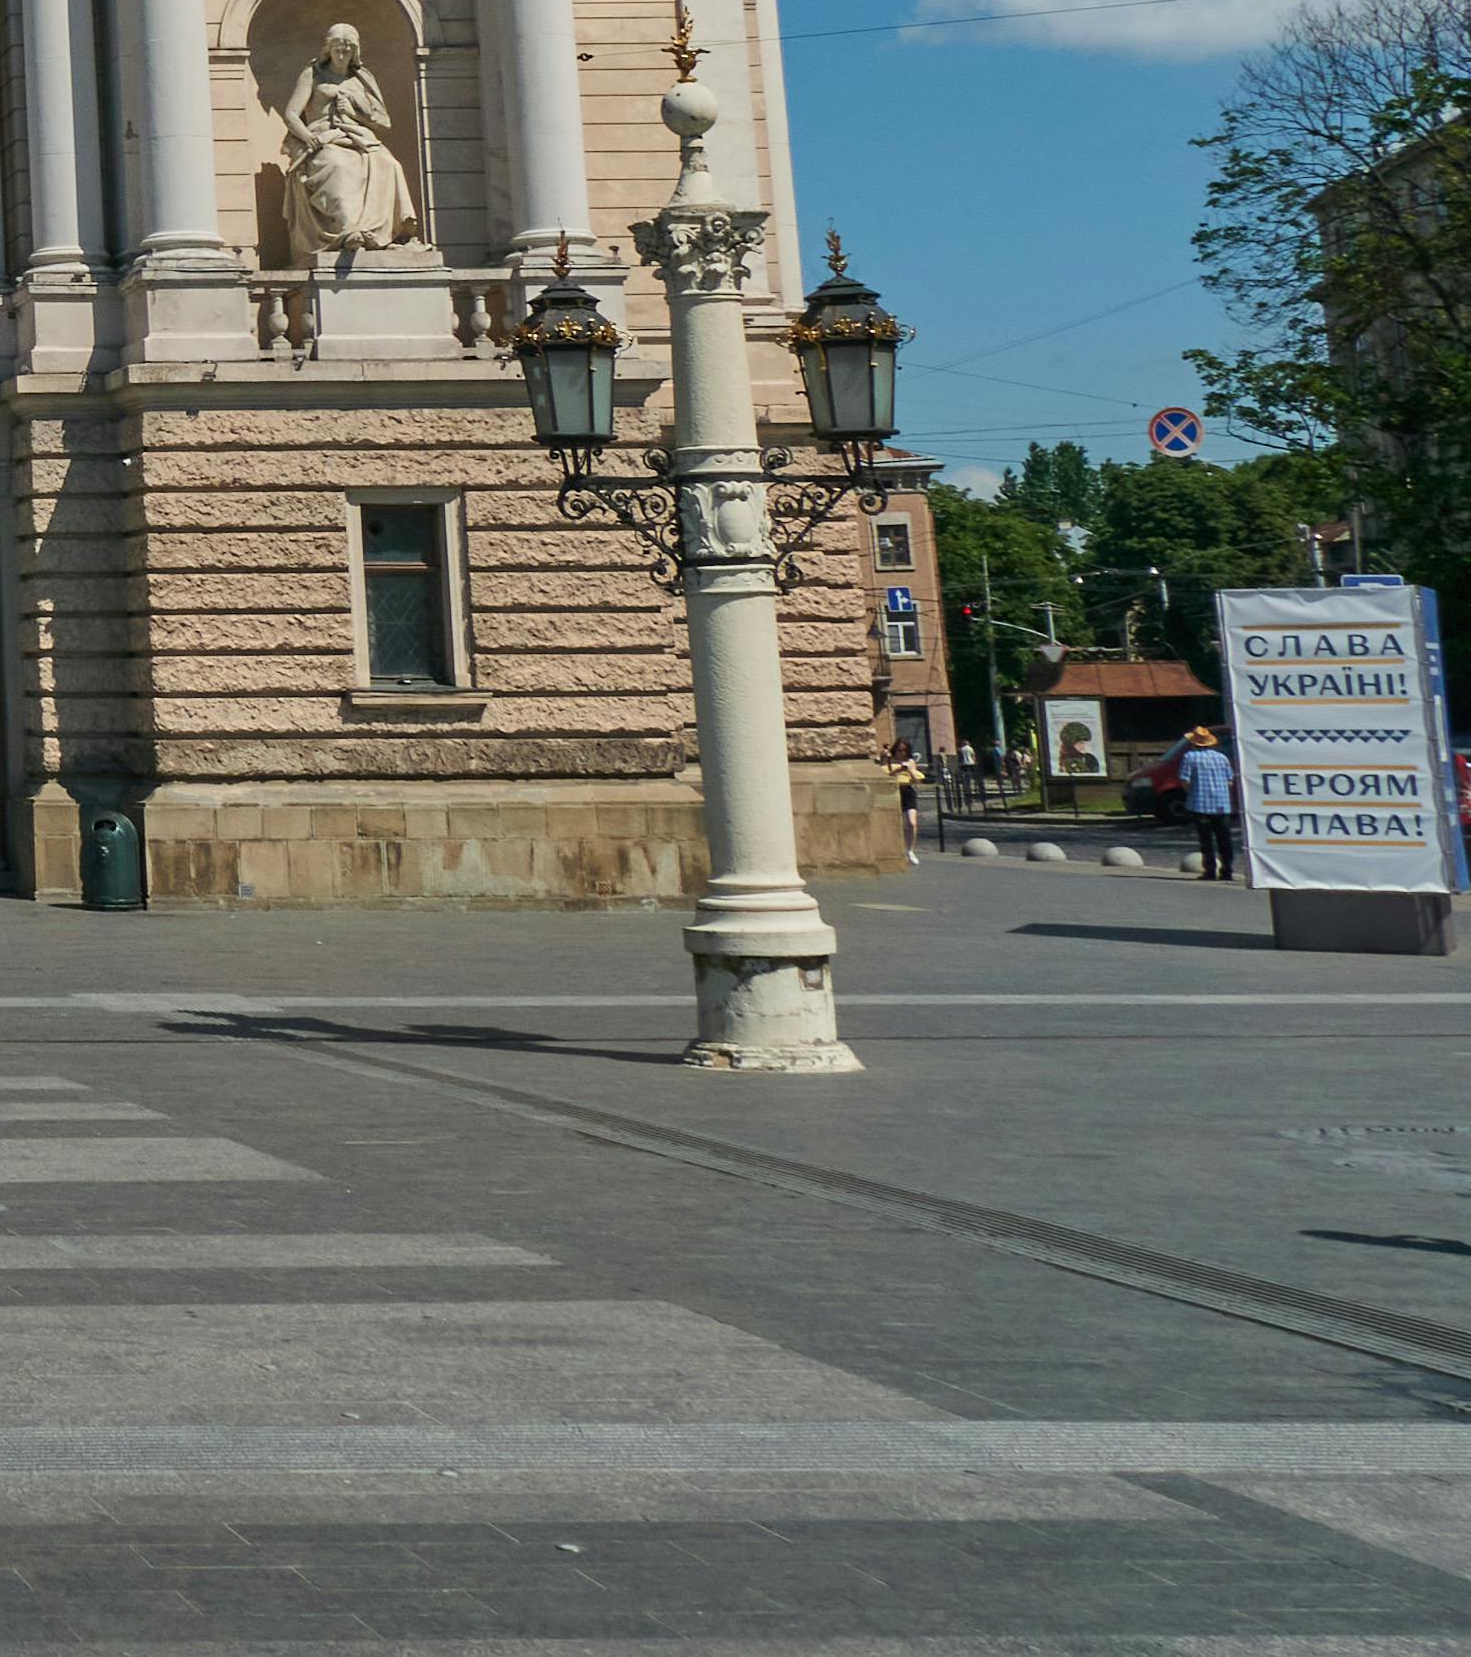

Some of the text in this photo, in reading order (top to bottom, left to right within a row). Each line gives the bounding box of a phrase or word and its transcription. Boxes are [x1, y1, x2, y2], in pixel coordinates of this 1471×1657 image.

[1244, 633, 1405, 658] СЛАВА
[1247, 666, 1408, 697] УКРАЇНІ!
[1261, 773, 1418, 796] ГЕРОЯМ
[1265, 812, 1424, 837] СЛАВА!
